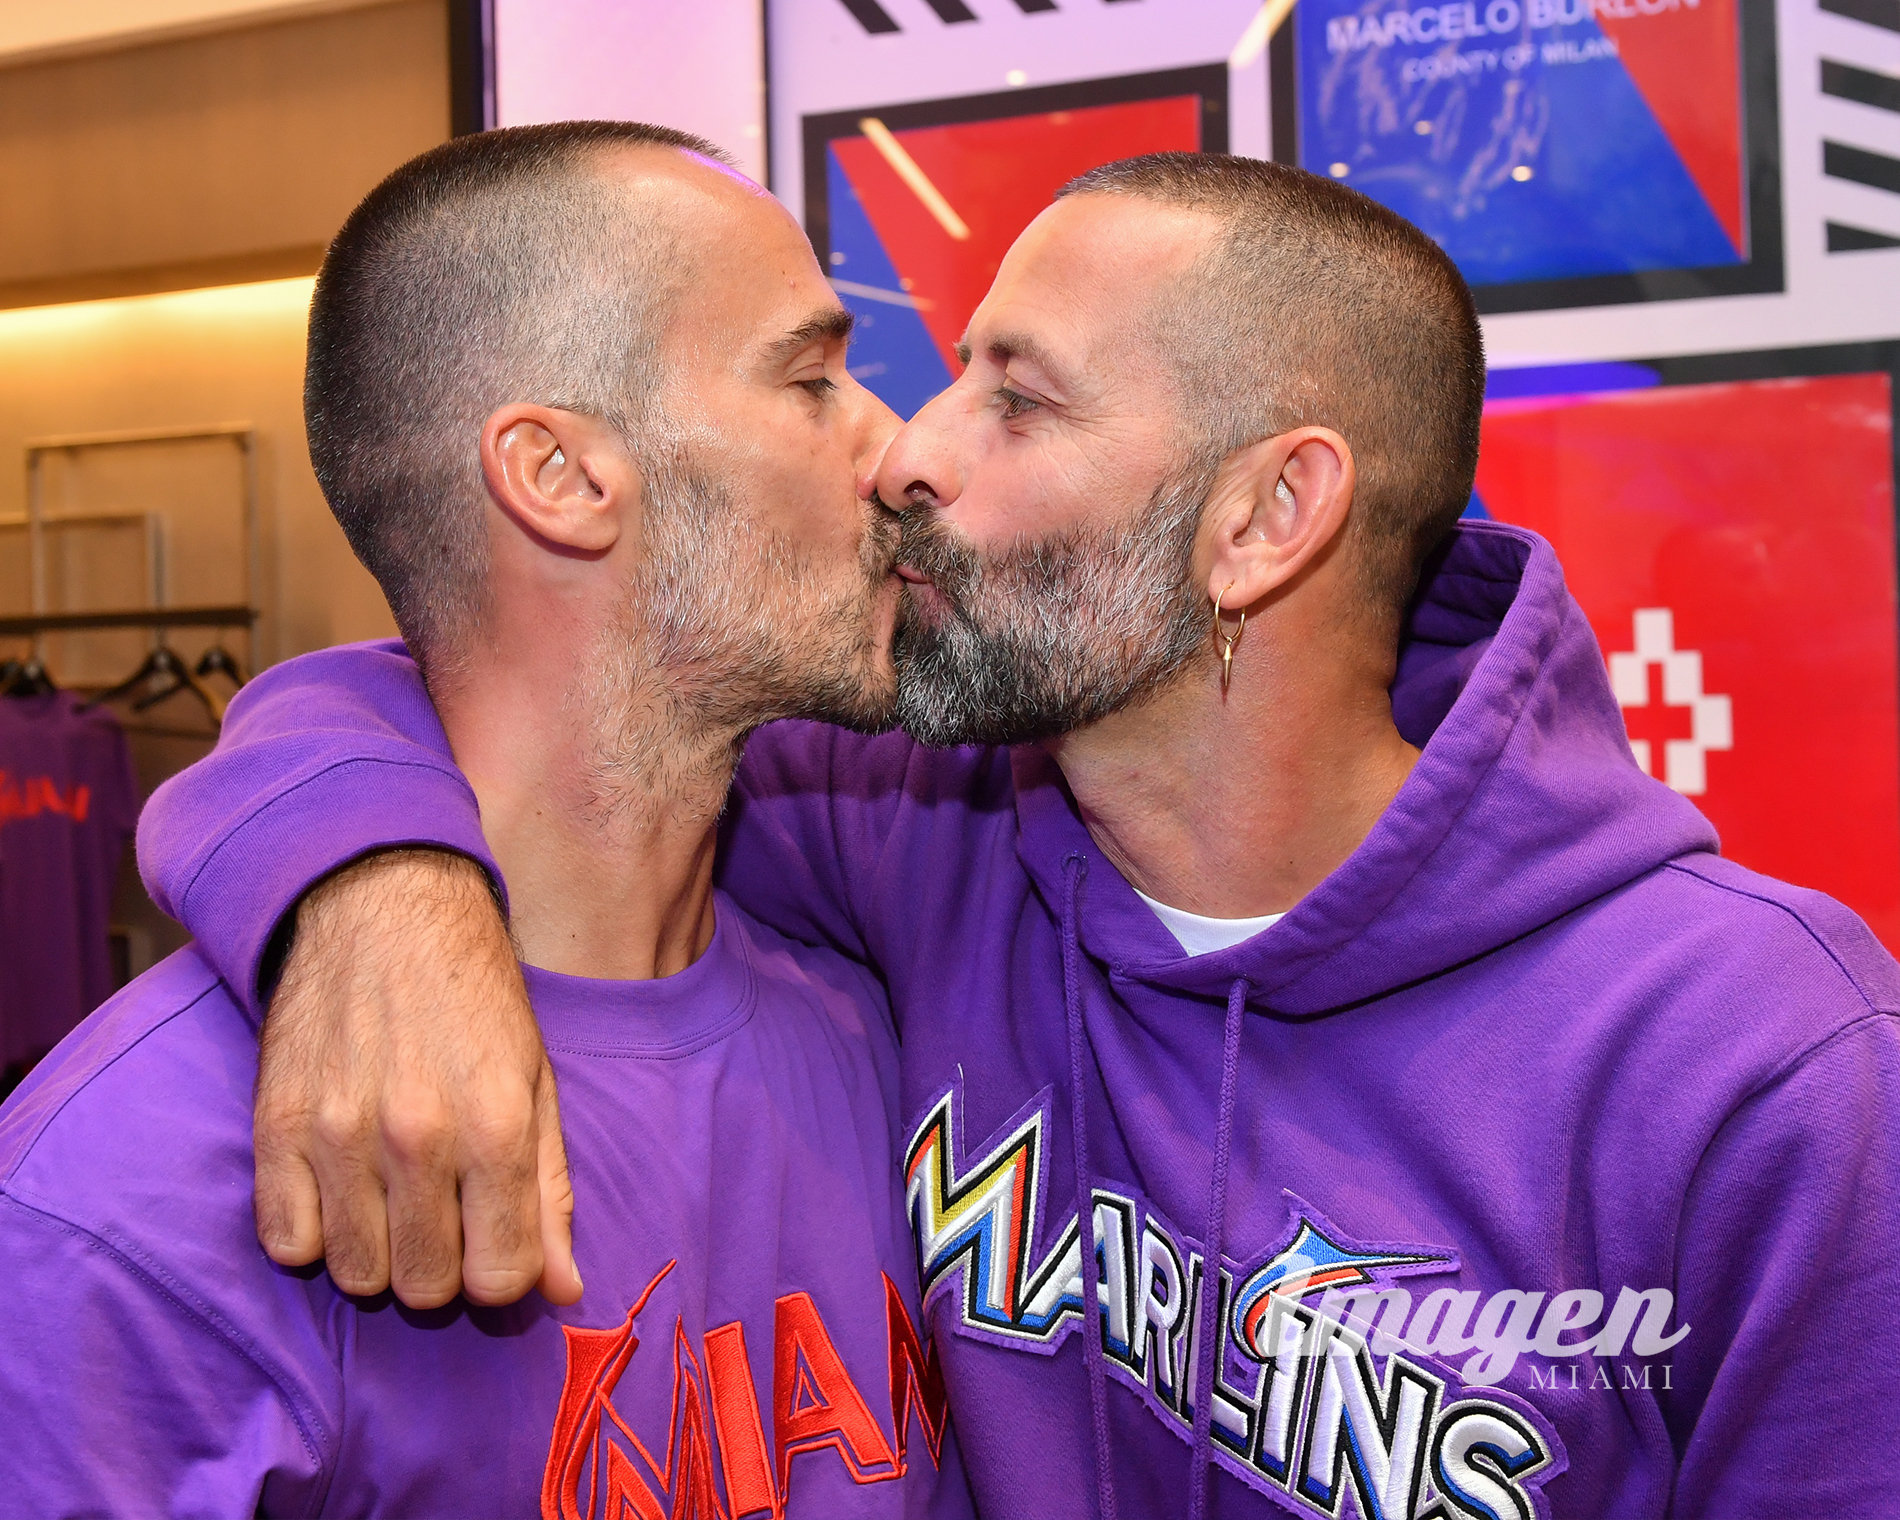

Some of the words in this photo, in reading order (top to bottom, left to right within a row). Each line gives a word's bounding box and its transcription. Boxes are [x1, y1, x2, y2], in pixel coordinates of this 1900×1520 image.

[1327, 0, 1520, 54] MARCELO
[1527, 0, 1699, 28] BURL
[1402, 48, 1499, 82] COUNTY
[1501, 43, 1533, 71] OF
[1541, 37, 1619, 65] MILAN
[904, 1085, 1553, 1520] MARLINS
